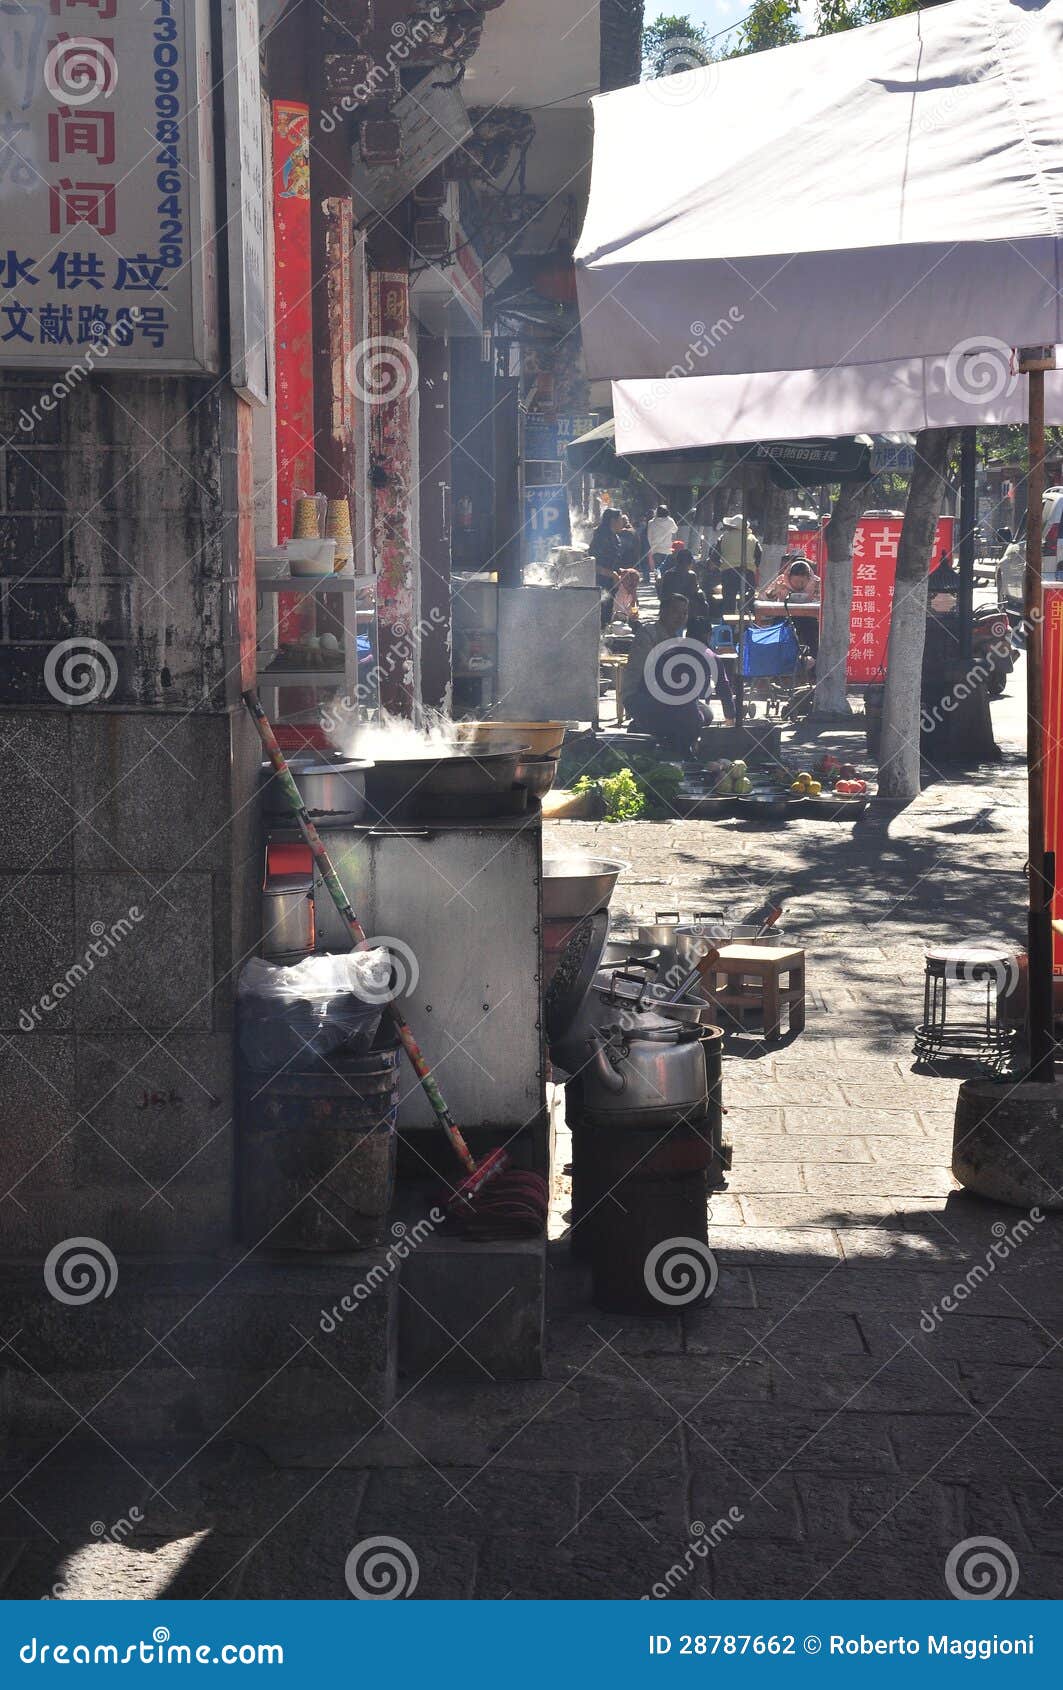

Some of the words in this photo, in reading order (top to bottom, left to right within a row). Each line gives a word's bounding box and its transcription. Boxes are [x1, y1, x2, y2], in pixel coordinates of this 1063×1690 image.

[0, 250, 169, 291] 水供应
[530, 507, 559, 530] IP
